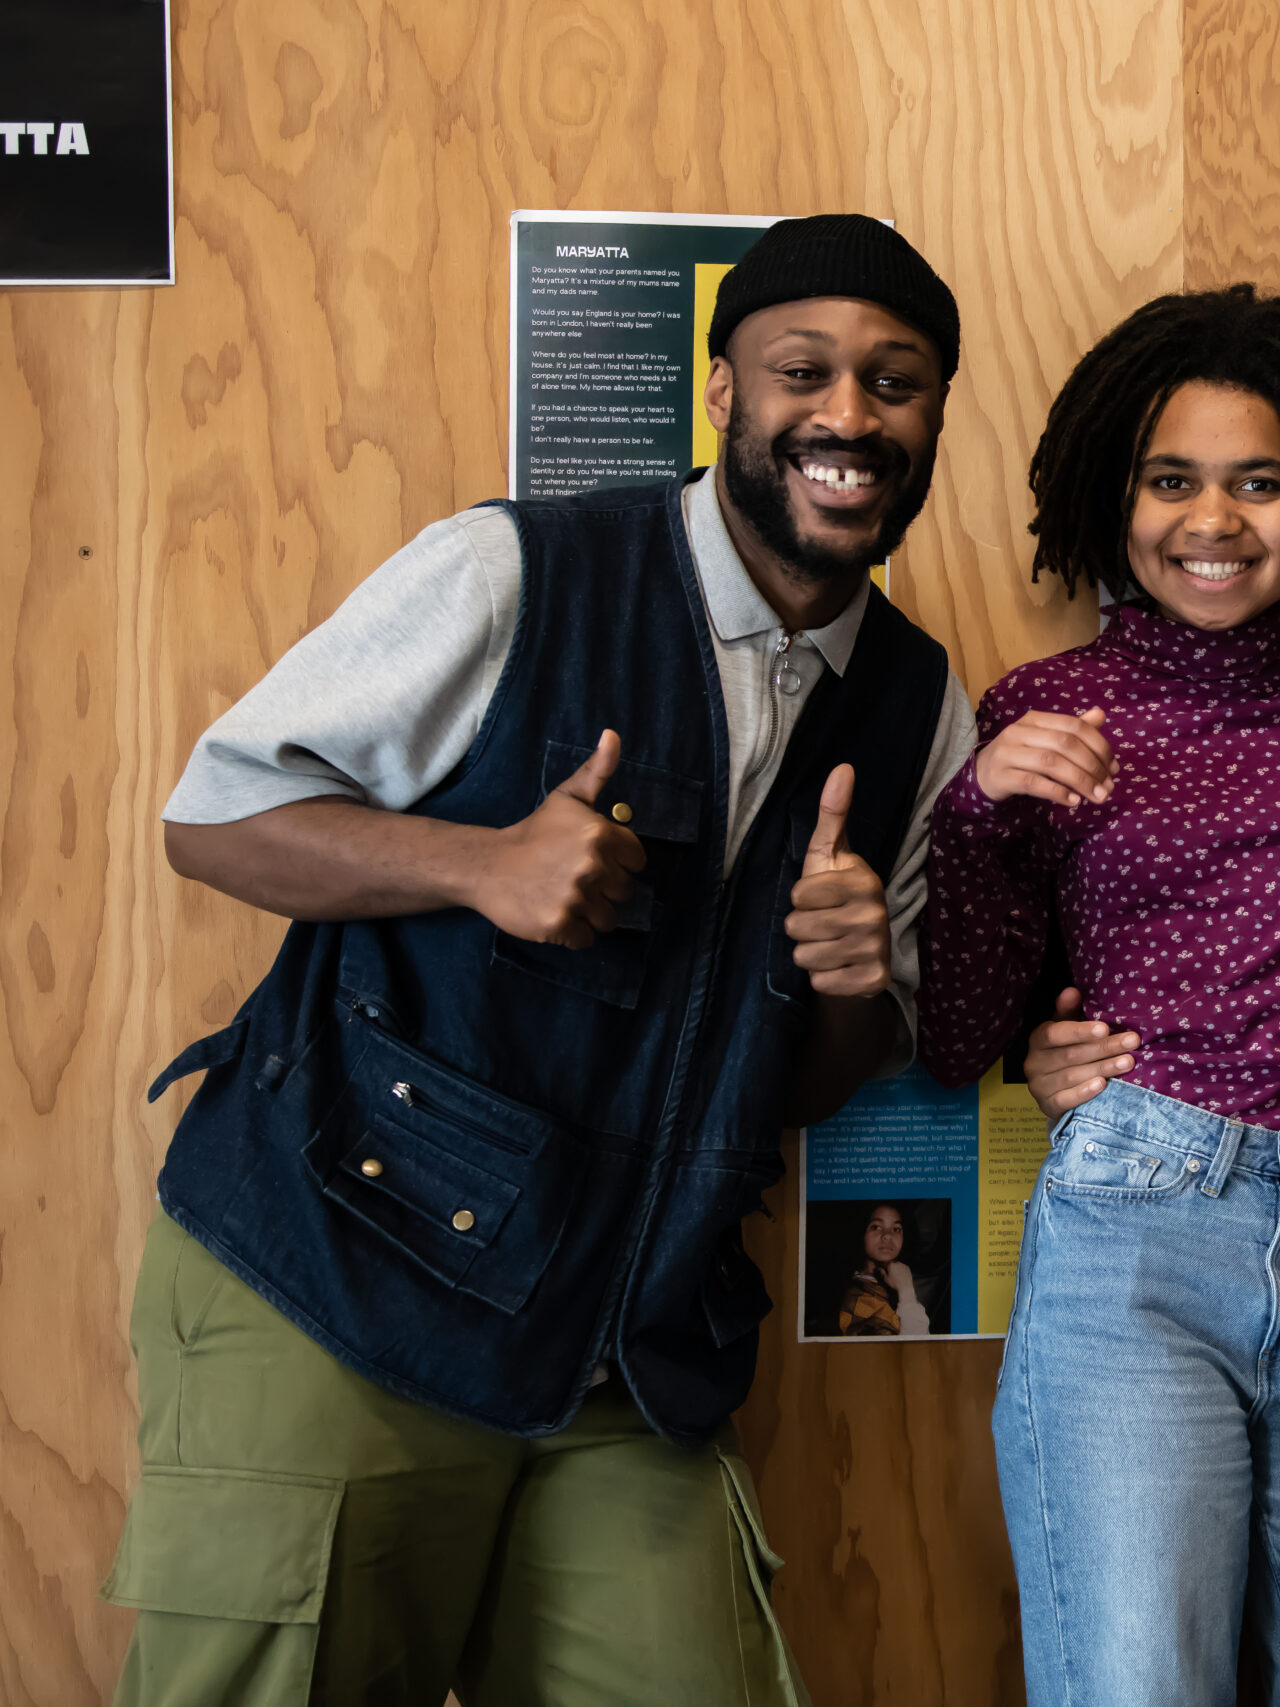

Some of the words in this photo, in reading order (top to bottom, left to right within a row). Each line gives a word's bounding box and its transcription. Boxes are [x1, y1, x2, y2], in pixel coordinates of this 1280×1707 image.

[556, 246, 629, 259] MARYATTA
[558, 266, 577, 274] know
[599, 269, 614, 277] your
[616, 268, 642, 277] parents
[643, 268, 666, 276] named
[668, 270, 680, 278] you
[532, 276, 569, 286] Maryatta?
[617, 278, 625, 286] of
[626, 280, 638, 288] my
[532, 286, 546, 294] and
[547, 288, 558, 296] my
[560, 287, 577, 295] dads
[532, 308, 555, 316] Would
[557, 310, 570, 318] you
[586, 309, 612, 319] England
[621, 312, 636, 320] your
[638, 310, 662, 318] home?
[532, 318, 548, 326] born
[616, 320, 634, 330] really
[635, 320, 653, 328] been
[532, 329, 566, 339] anywhere
[532, 350, 556, 358] Where
[583, 351, 596, 359] feel
[626, 352, 649, 360] home?
[650, 352, 656, 360] In
[657, 354, 668, 362] my
[569, 362, 582, 371] just
[607, 362, 620, 370] find
[654, 365, 665, 373] my
[532, 373, 563, 381] company
[565, 372, 578, 380] and
[579, 372, 590, 380] I'm
[624, 373, 639, 381] who
[640, 373, 660, 381] needs
[532, 382, 539, 390] of
[541, 382, 560, 390] alone
[580, 383, 591, 392] My
[592, 383, 612, 391] home
[532, 403, 536, 411] If
[538, 405, 551, 413] you
[573, 404, 598, 412] chance
[599, 404, 607, 412] to
[609, 404, 629, 414] speak
[631, 406, 646, 414] your
[648, 405, 665, 413] heart
[667, 405, 675, 413] to
[633, 415, 648, 423] who
[531, 424, 545, 432] be?
[554, 435, 572, 445] really
[598, 438, 622, 446] person
[622, 436, 631, 444] to
[530, 456, 540, 464] Do
[542, 458, 554, 466] you
[598, 457, 615, 465] have
[623, 458, 645, 467] strong
[668, 458, 675, 466] of
[531, 467, 556, 476] identity
[566, 467, 576, 475] do
[577, 469, 590, 477] you
[619, 468, 641, 478] you're
[642, 468, 654, 476] still
[655, 468, 677, 478] finding
[531, 477, 542, 485] out
[544, 477, 566, 485] where
[568, 479, 580, 487] you
